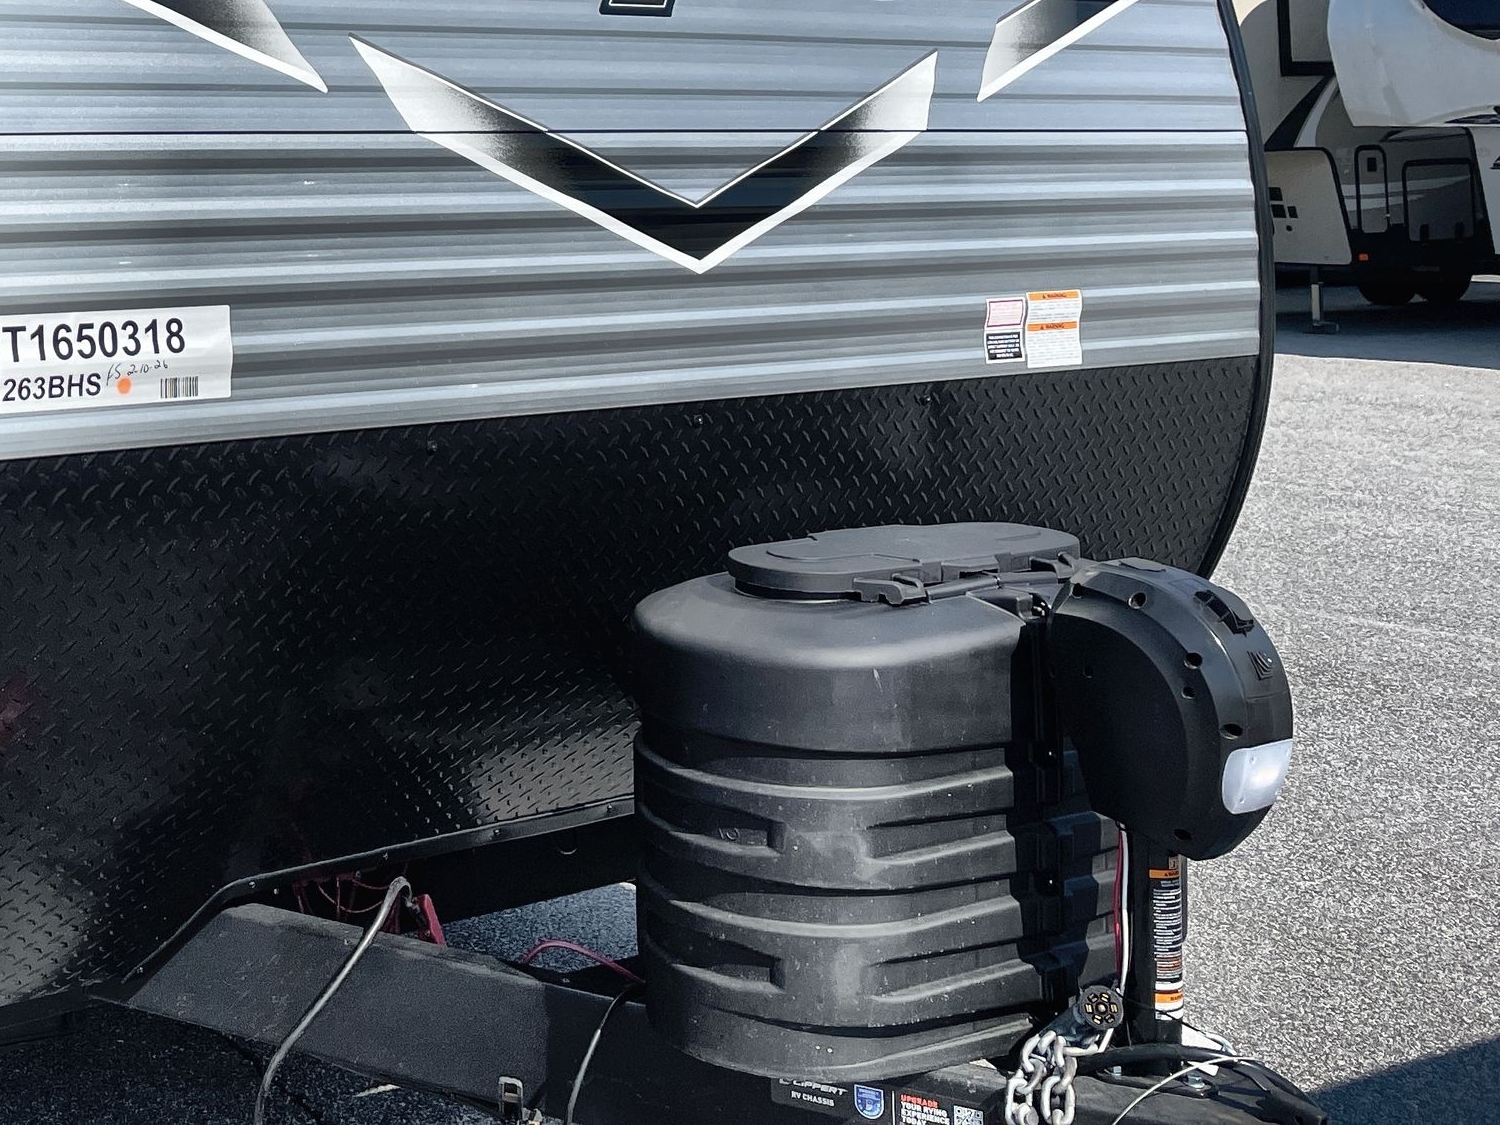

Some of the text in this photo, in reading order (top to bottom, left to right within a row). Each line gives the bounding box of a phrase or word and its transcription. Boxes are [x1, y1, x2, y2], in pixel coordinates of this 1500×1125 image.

[2, 318, 186, 363] T1650318
[2, 373, 101, 402] 263BHS
[802, 1093, 835, 1106] CHASSIS
[900, 1094, 938, 1108] UPGRADE
[900, 1101, 922, 1112] YOUR
[900, 1109, 950, 1125] EXPERIENCE
